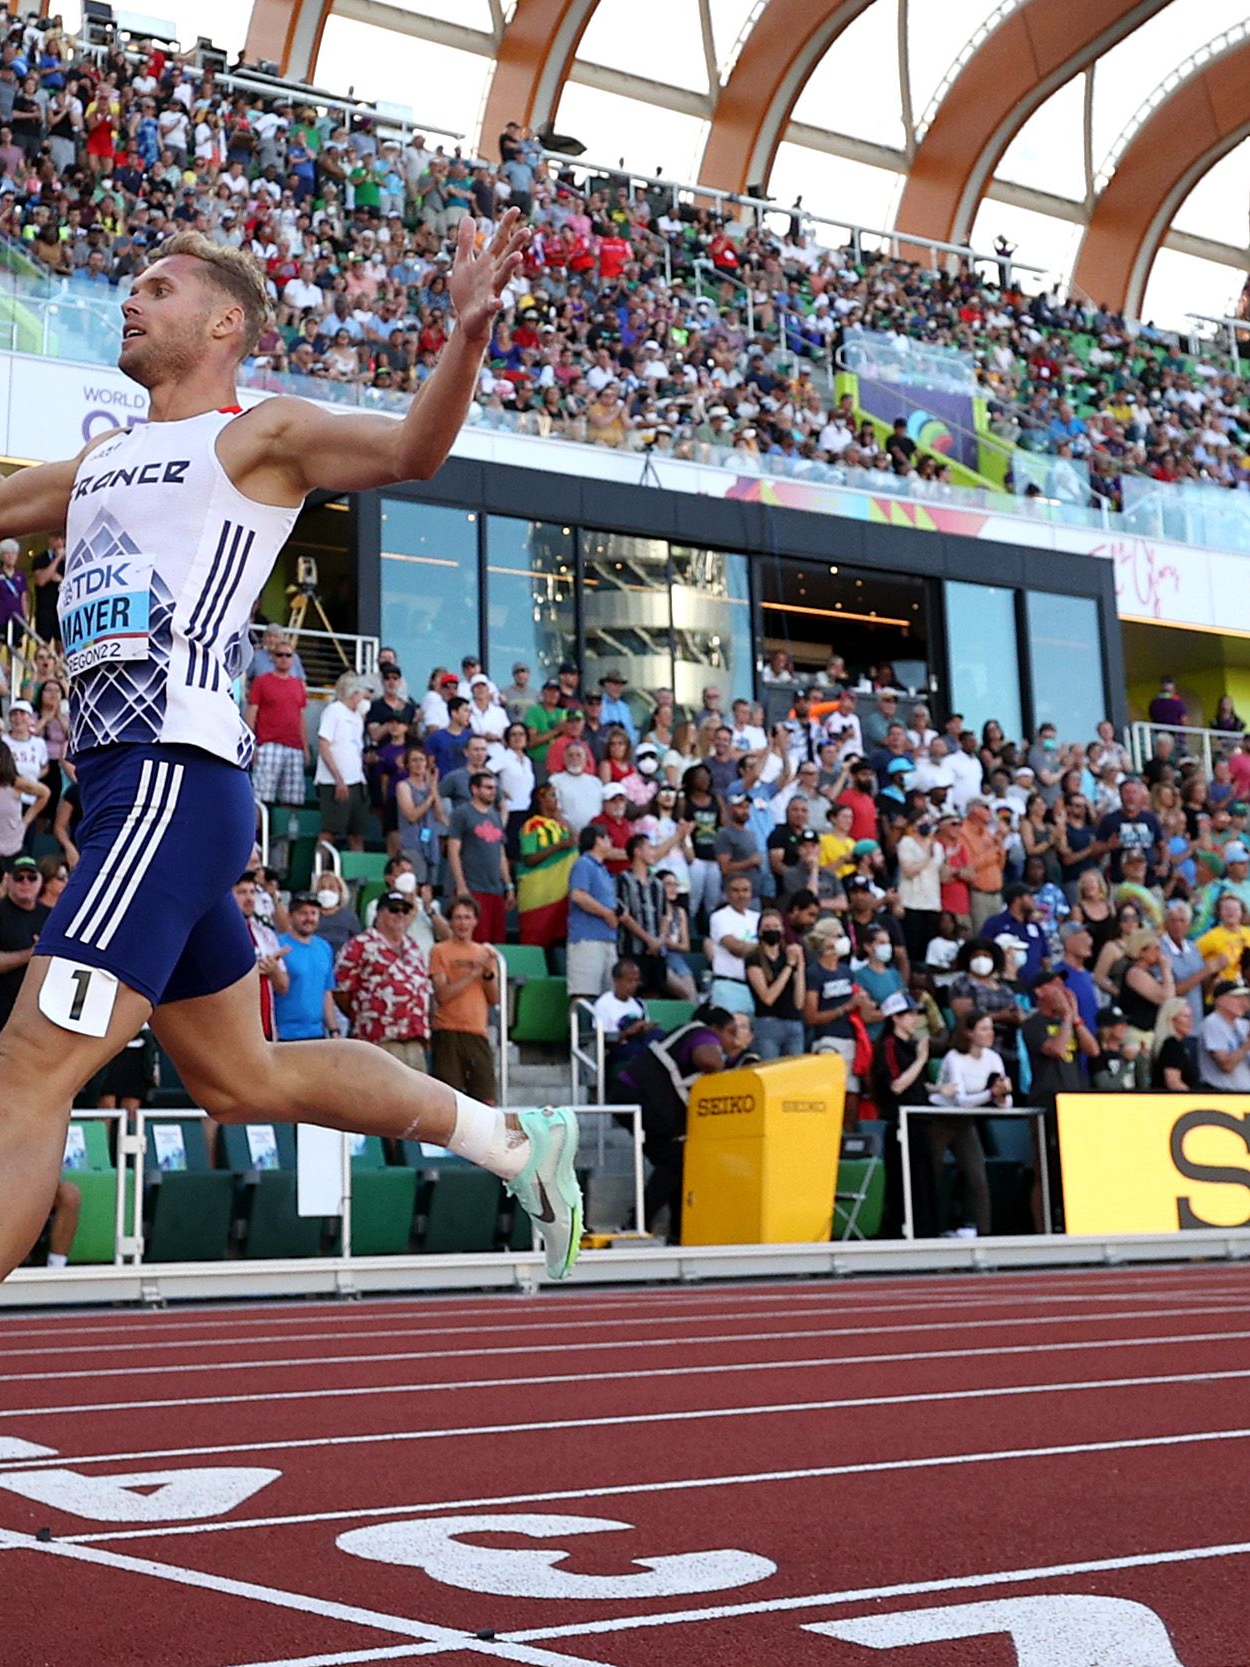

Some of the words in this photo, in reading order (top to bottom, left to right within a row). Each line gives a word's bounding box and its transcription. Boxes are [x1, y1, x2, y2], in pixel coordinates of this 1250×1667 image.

[83, 386, 146, 409] WORLD
[72, 562, 132, 600] TDK
[69, 642, 122, 673] REGON22
[69, 969, 93, 1021] 1
[697, 1094, 756, 1117] SEIKO
[781, 1101, 827, 1114] SEIKO
[334, 1513, 778, 1600] 3
